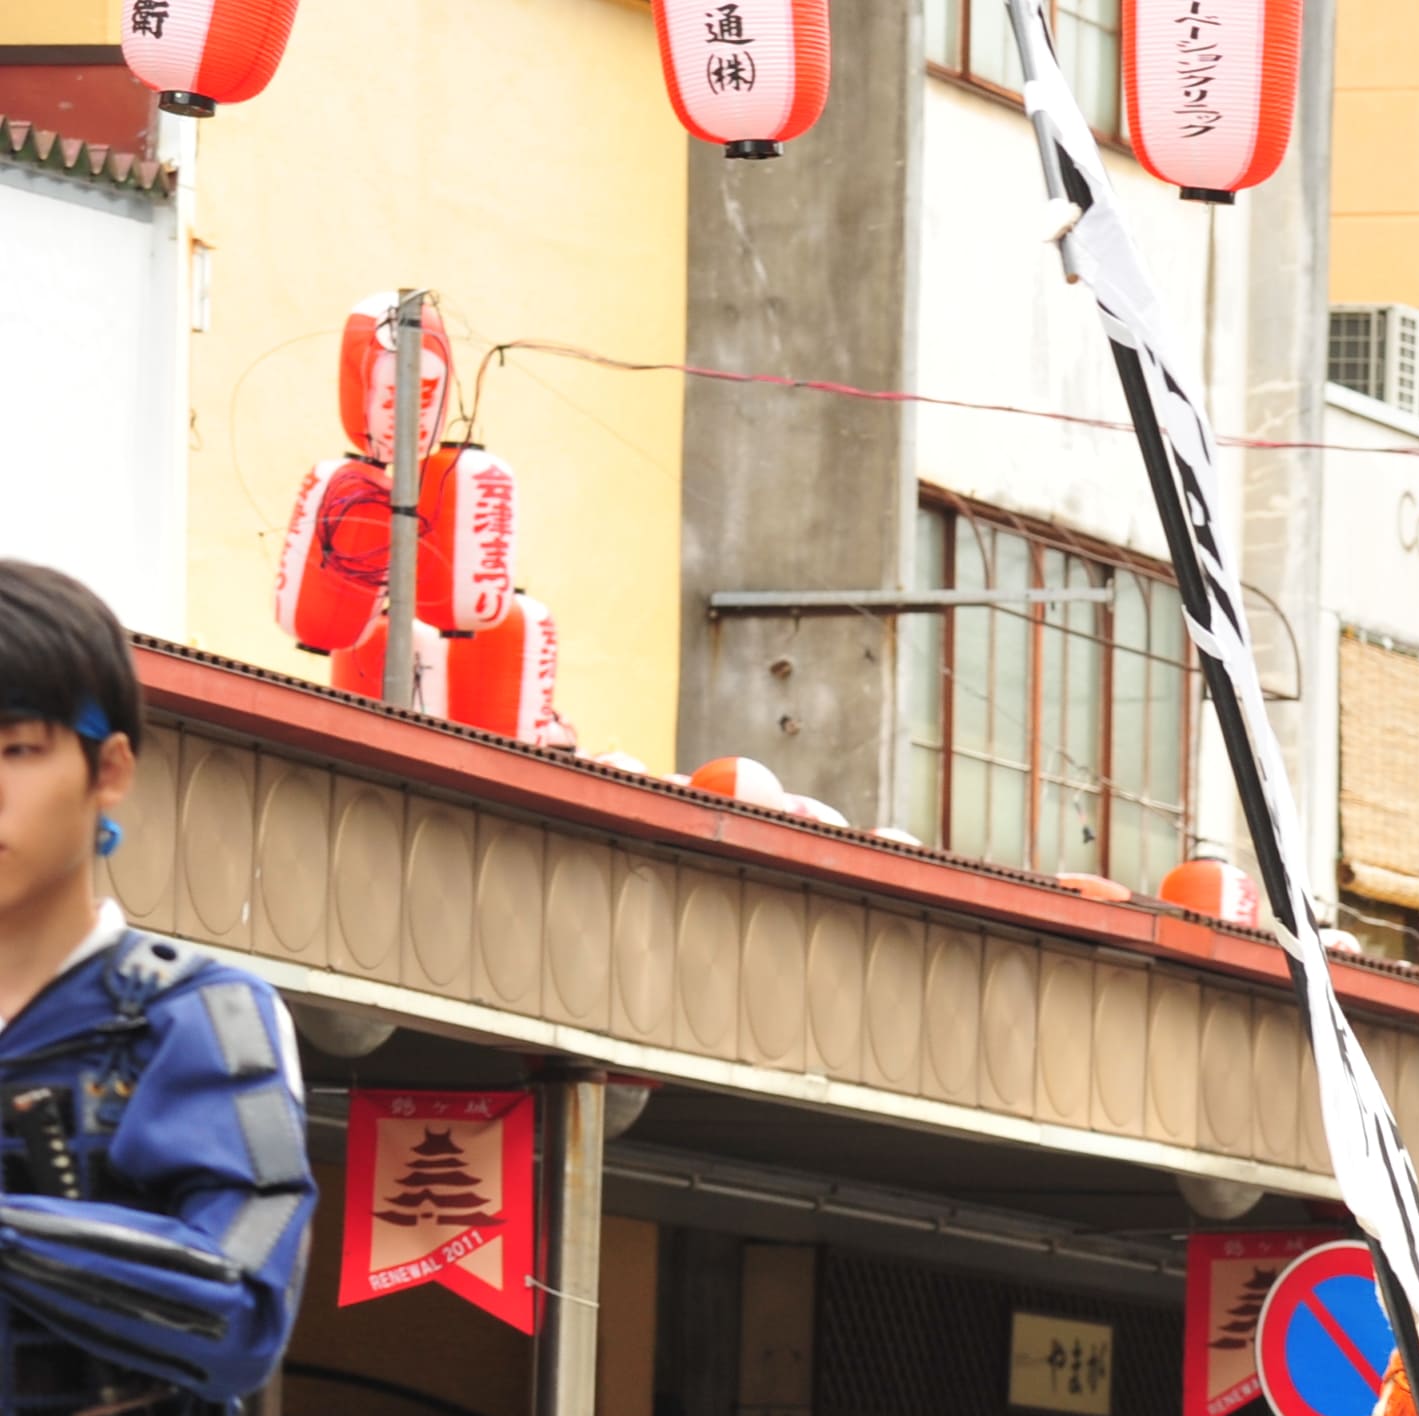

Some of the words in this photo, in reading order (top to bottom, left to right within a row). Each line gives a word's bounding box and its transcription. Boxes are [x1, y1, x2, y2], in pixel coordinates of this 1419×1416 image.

[368, 1256, 443, 1291] RENEWAL
[442, 1230, 484, 1263] 2011
[1207, 1377, 1260, 1416] RENEWA
